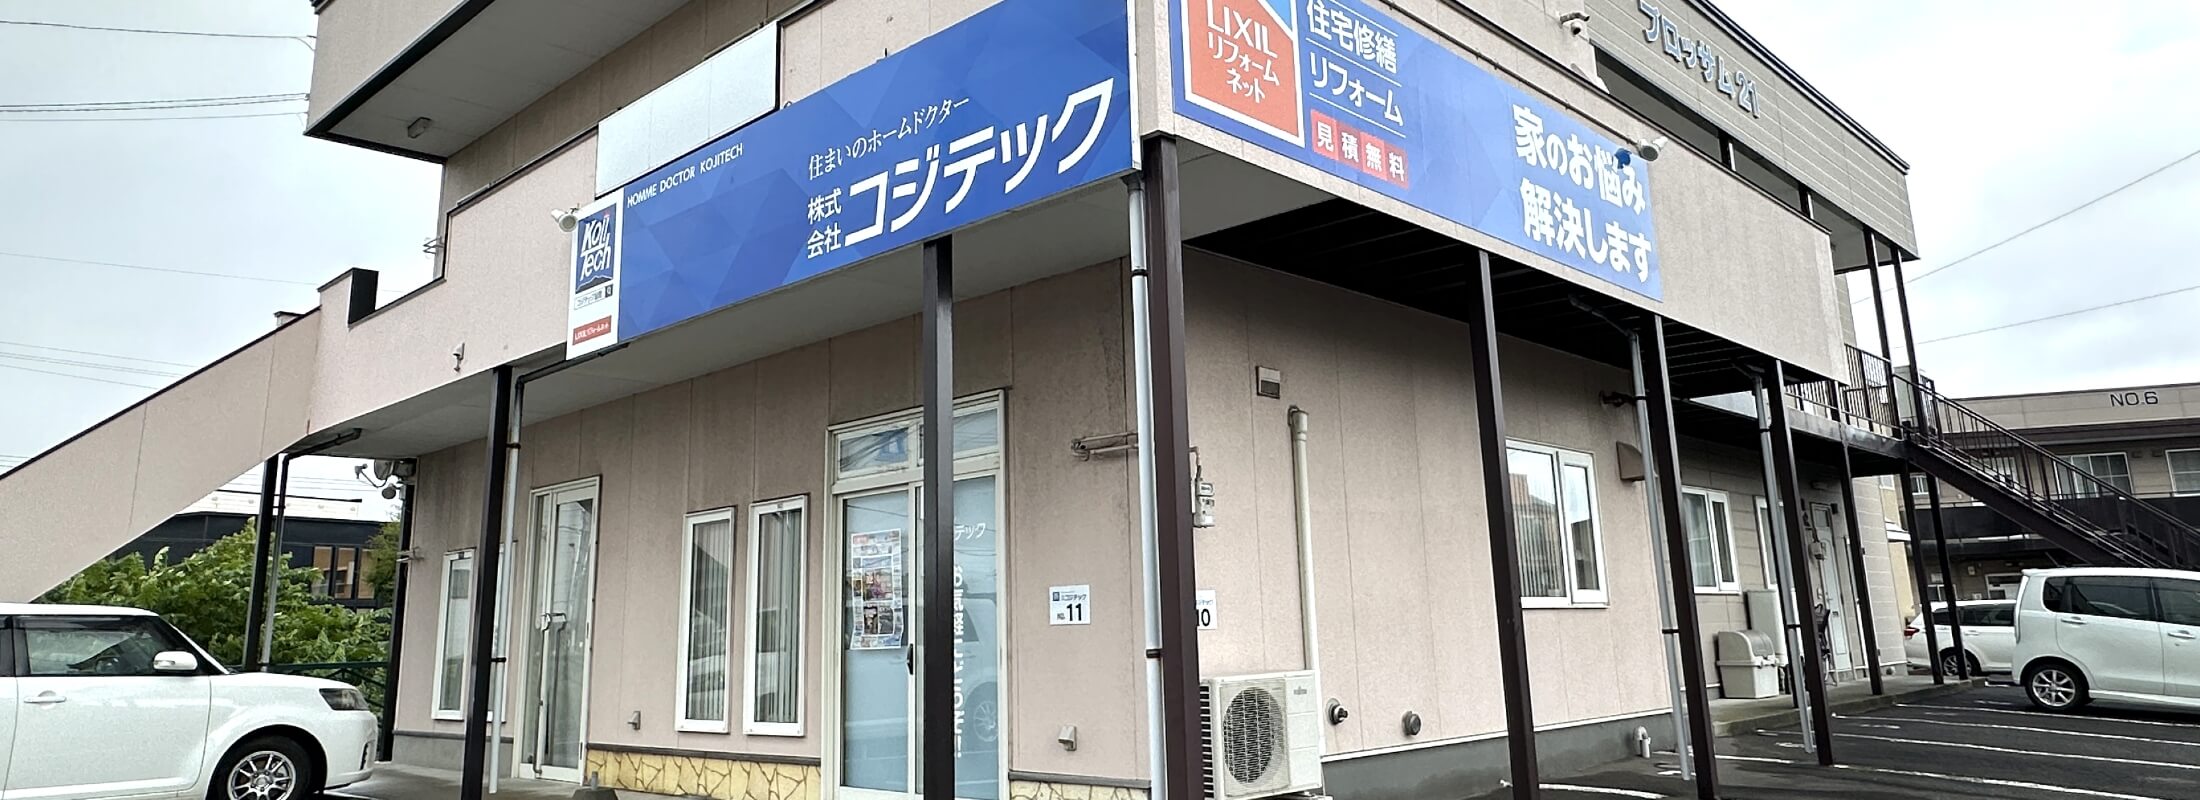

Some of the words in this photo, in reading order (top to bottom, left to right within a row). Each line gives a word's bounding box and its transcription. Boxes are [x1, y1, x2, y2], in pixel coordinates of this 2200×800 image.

[1206, 0, 1278, 58] LIXIL
[1307, 0, 1397, 74] 住宅修繕
[1207, 32, 1280, 87] リフォーム
[1226, 67, 1266, 103] ネット
[1310, 52, 1404, 127] リフォーム
[808, 97, 969, 181] 住まいのホームドクター
[844, 78, 1114, 248] コジテック
[1317, 121, 1404, 181] 見積無料
[1513, 104, 1646, 216] 家のお悩み
[627, 183, 658, 208] HOMME
[660, 166, 695, 193] DOCTOR
[700, 143, 743, 174] KOJITECH
[807, 188, 842, 225] 株式
[1520, 177, 1652, 283] 解決します
[807, 222, 842, 260] 会社
[2110, 391, 2158, 407] NO.6
[1066, 603, 1082, 621] 11
